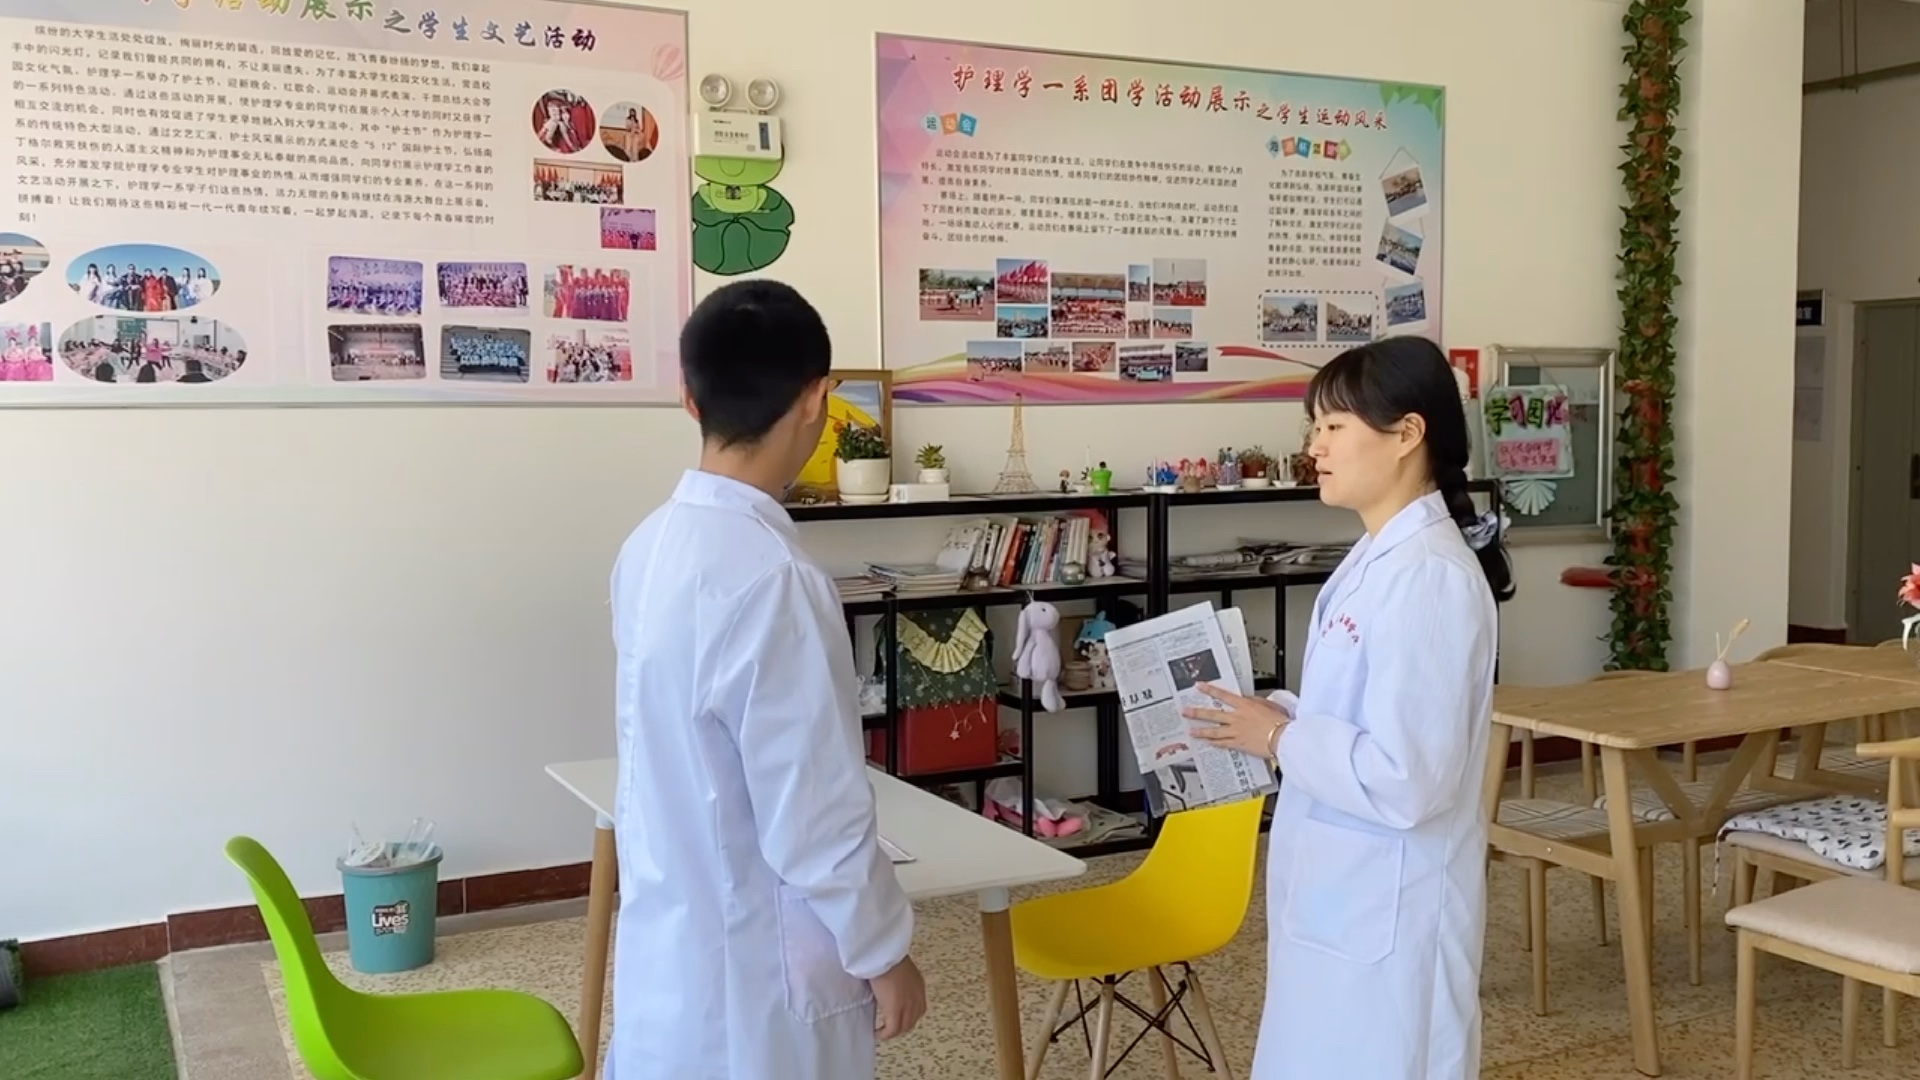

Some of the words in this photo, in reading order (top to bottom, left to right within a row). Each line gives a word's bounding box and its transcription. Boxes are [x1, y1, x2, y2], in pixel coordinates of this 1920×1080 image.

[142, 0, 597, 52] 展示之学生文艺活动
[952, 64, 1388, 131] 护理学一系团学活动展示之学生运动风采
[926, 114, 974, 133] 运动会
[1485, 391, 1568, 436] 学习园地
[371, 912, 409, 928] Lives
